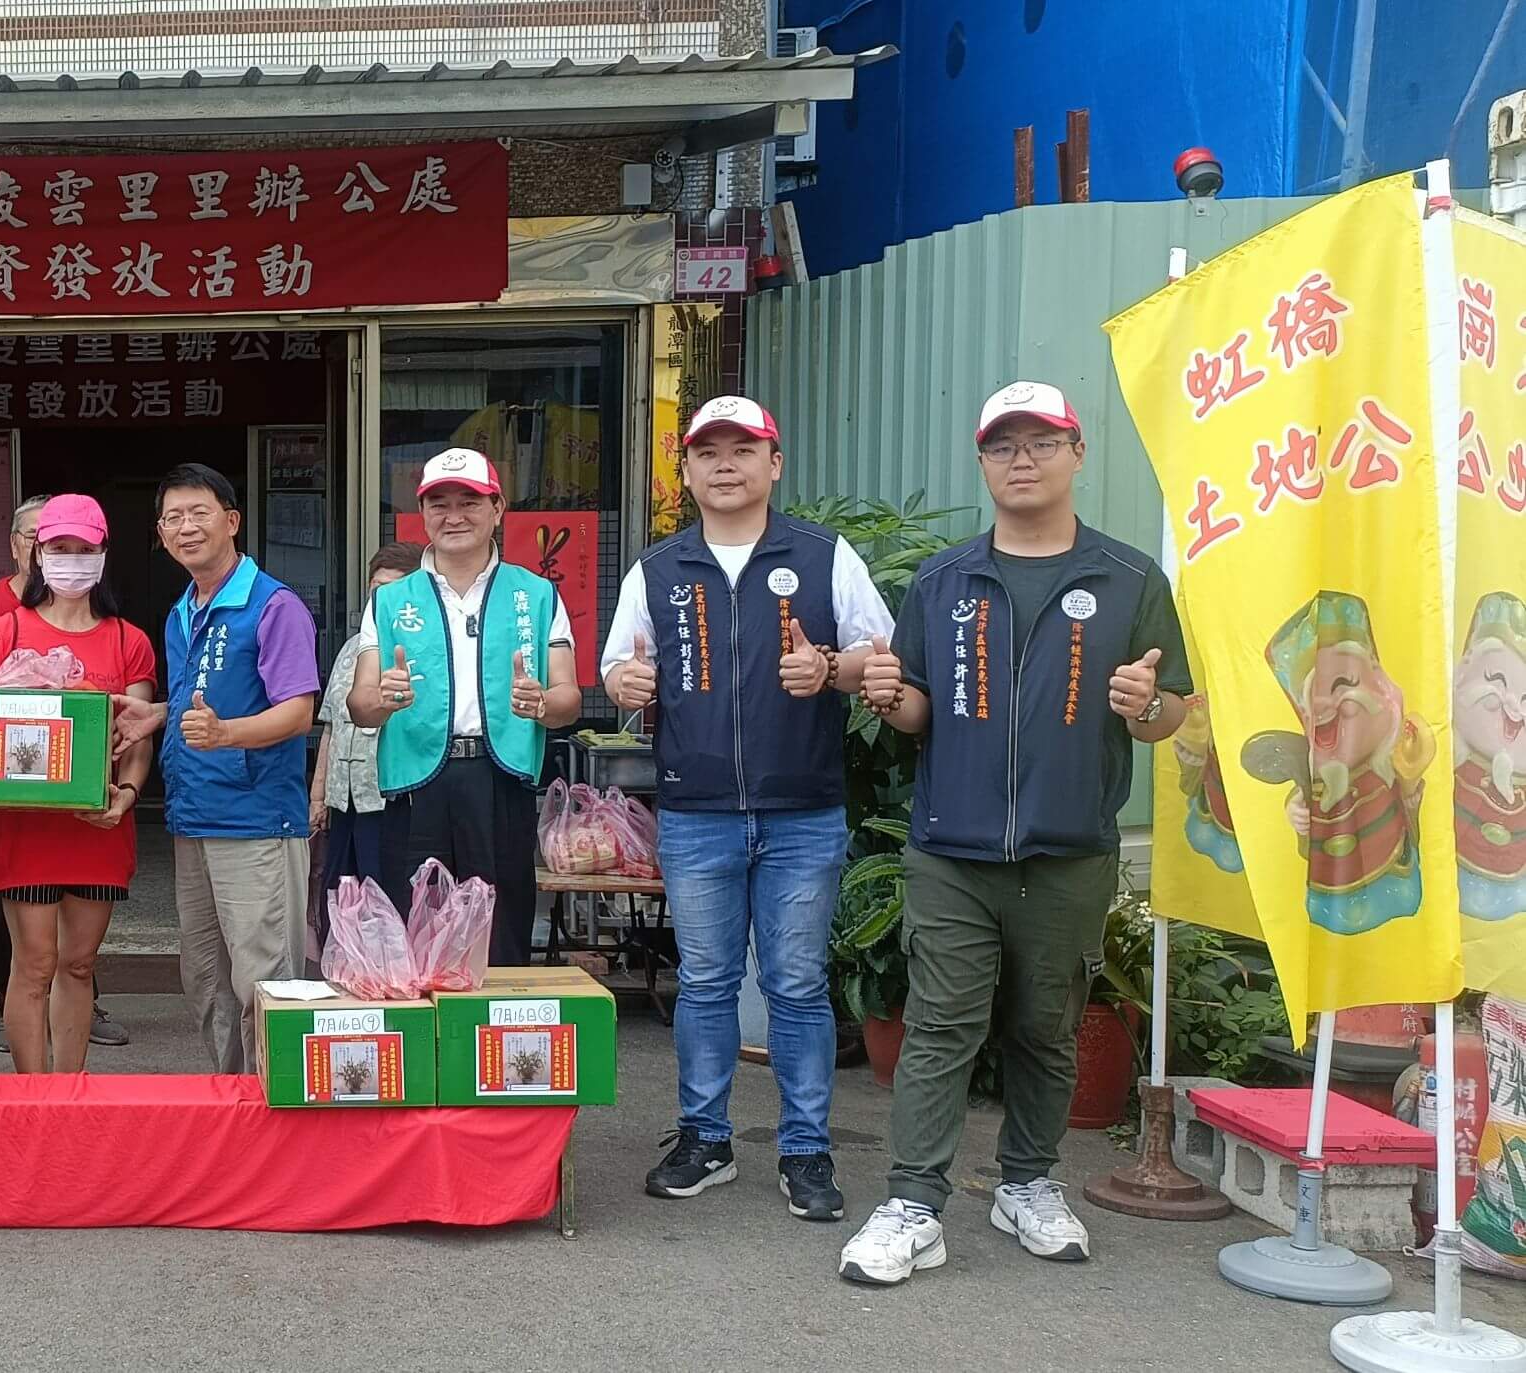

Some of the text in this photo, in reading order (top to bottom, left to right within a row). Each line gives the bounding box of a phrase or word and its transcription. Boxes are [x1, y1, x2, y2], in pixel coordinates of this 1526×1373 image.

[697, 266, 732, 289] 42
[667, 316, 685, 368] 龍潭區
[1185, 273, 1348, 419] 虹橋
[1185, 399, 1412, 559] 土地公
[195, 626, 215, 699] 里長陳
[214, 623, 228, 671] 凌雲里
[513, 589, 536, 678] 隆祥經濟發展
